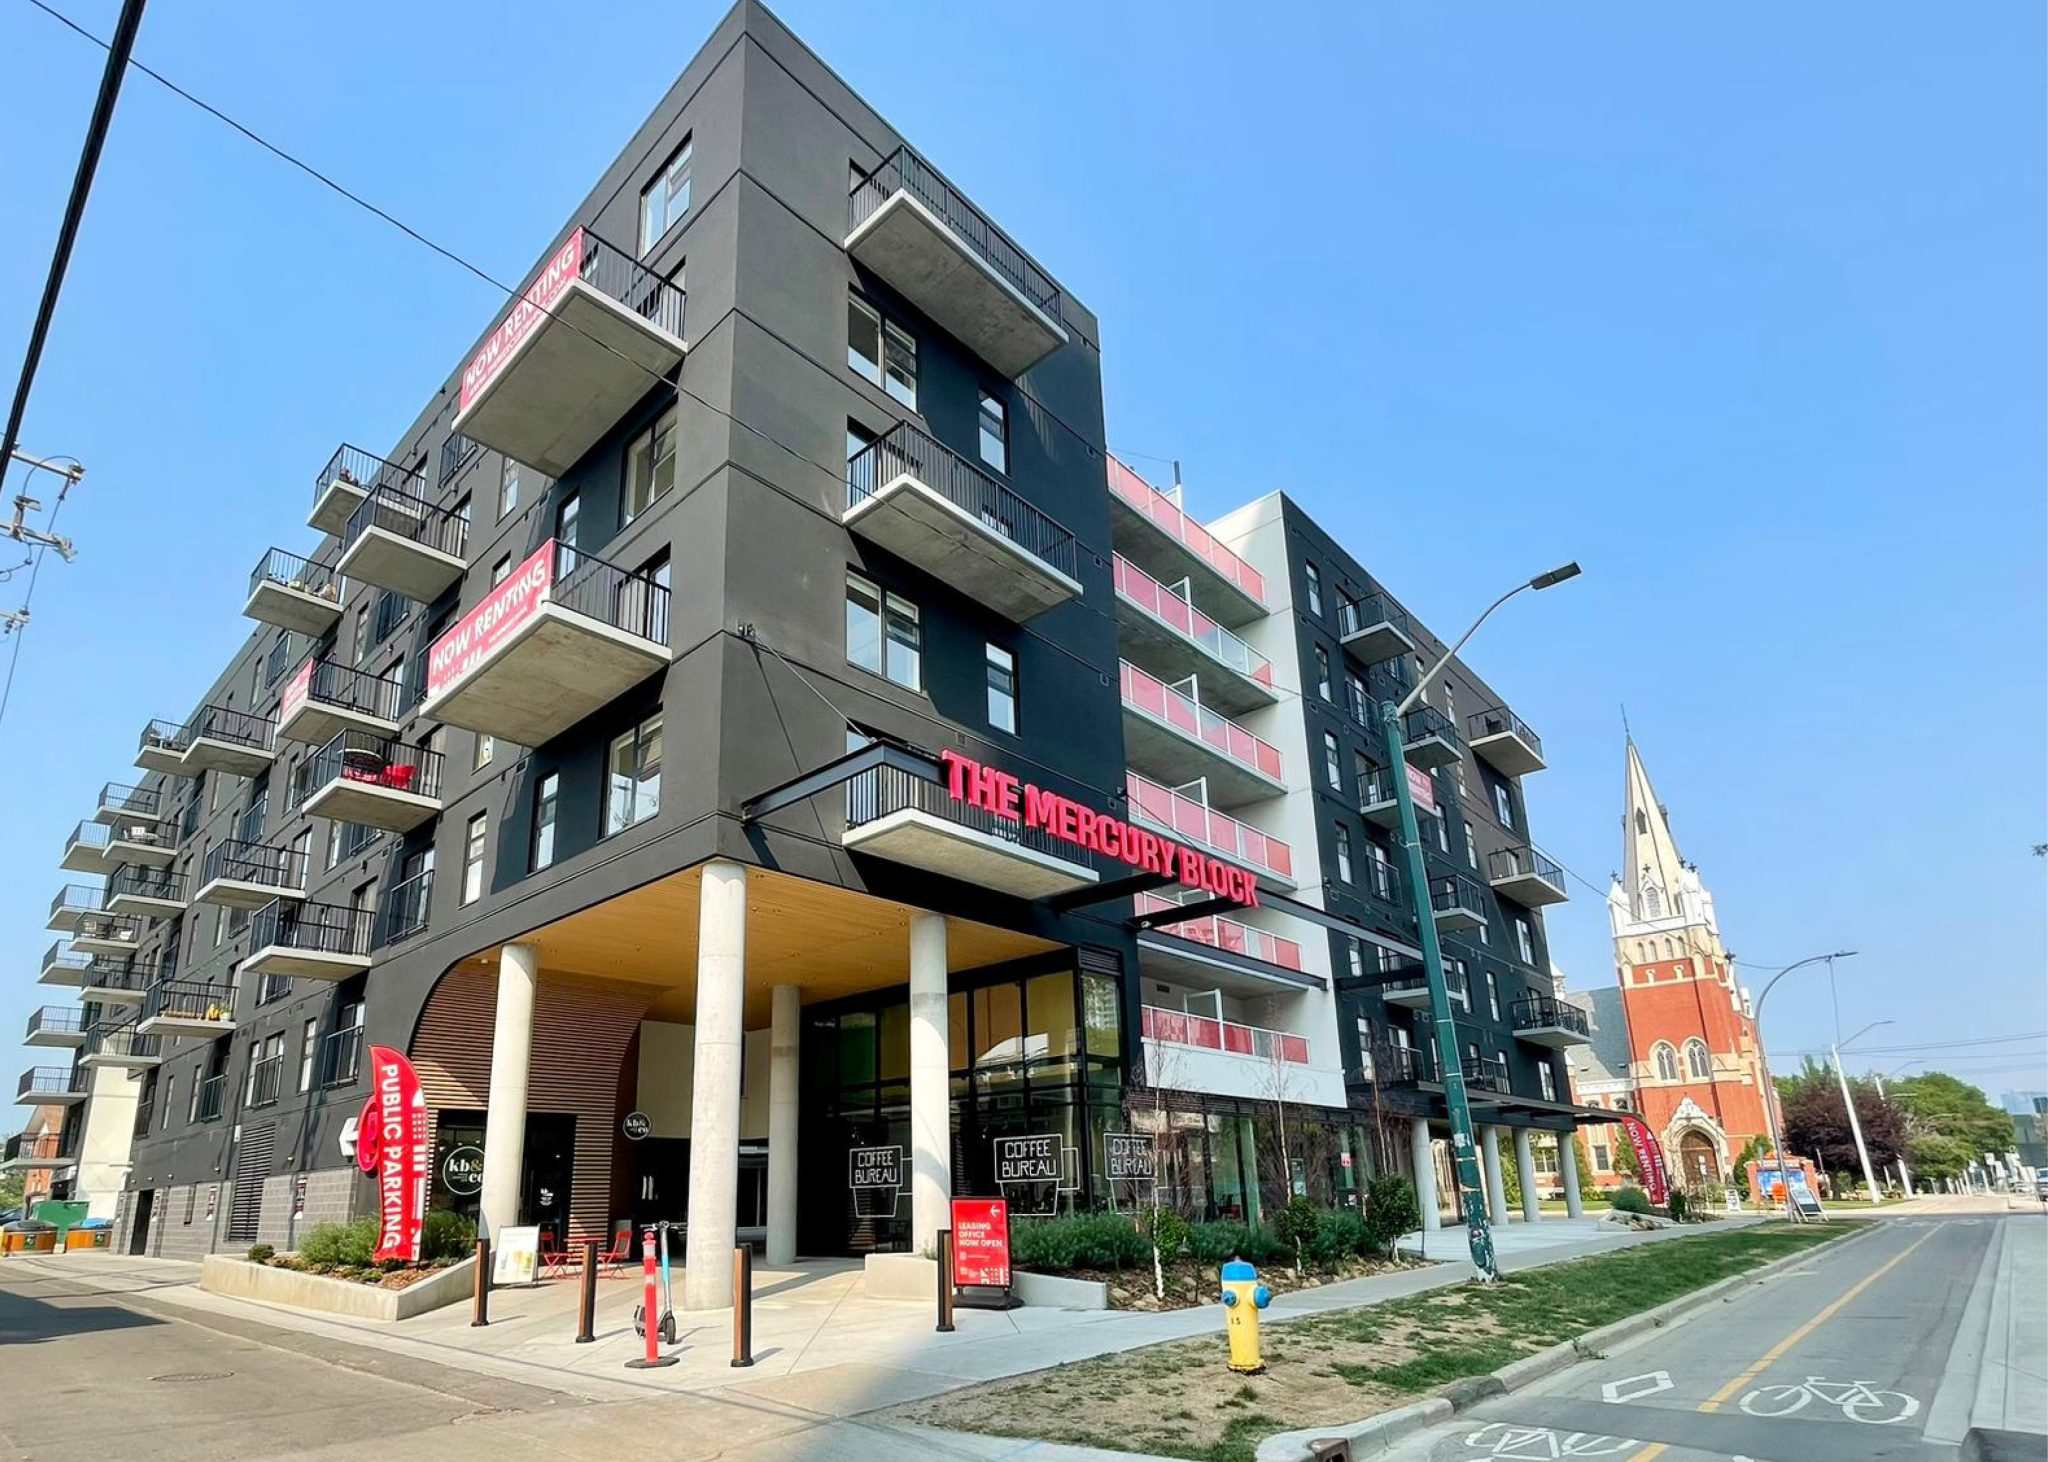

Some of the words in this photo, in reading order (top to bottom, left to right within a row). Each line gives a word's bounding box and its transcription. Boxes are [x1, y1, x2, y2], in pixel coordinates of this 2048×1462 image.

[466, 327, 502, 388] NOW
[503, 243, 576, 340] RENTING
[432, 624, 471, 675] NOW
[474, 558, 546, 642] RENTING
[942, 749, 1020, 821] THE
[1024, 783, 1176, 878] MERCURY
[1178, 846, 1260, 909] BLOCK
[381, 1063, 402, 1140] PUBLIC
[1005, 1139, 1052, 1158] COFFEE
[1112, 1138, 1147, 1155] COFFEE
[858, 1151, 894, 1167] COFFEE
[1626, 1122, 1643, 1147] NOW
[1638, 1148, 1657, 1191] RENTING
[855, 1167, 897, 1184] BUREAU
[1002, 1158, 1057, 1178] BUREAU
[1111, 1157, 1151, 1176] BUREAU
[383, 1146, 402, 1249] PARKING
[958, 1222, 992, 1231] LEASING
[958, 1230, 986, 1239] OFFICE
[958, 1240, 979, 1248] NOW
[981, 1239, 1003, 1248] OPEN
